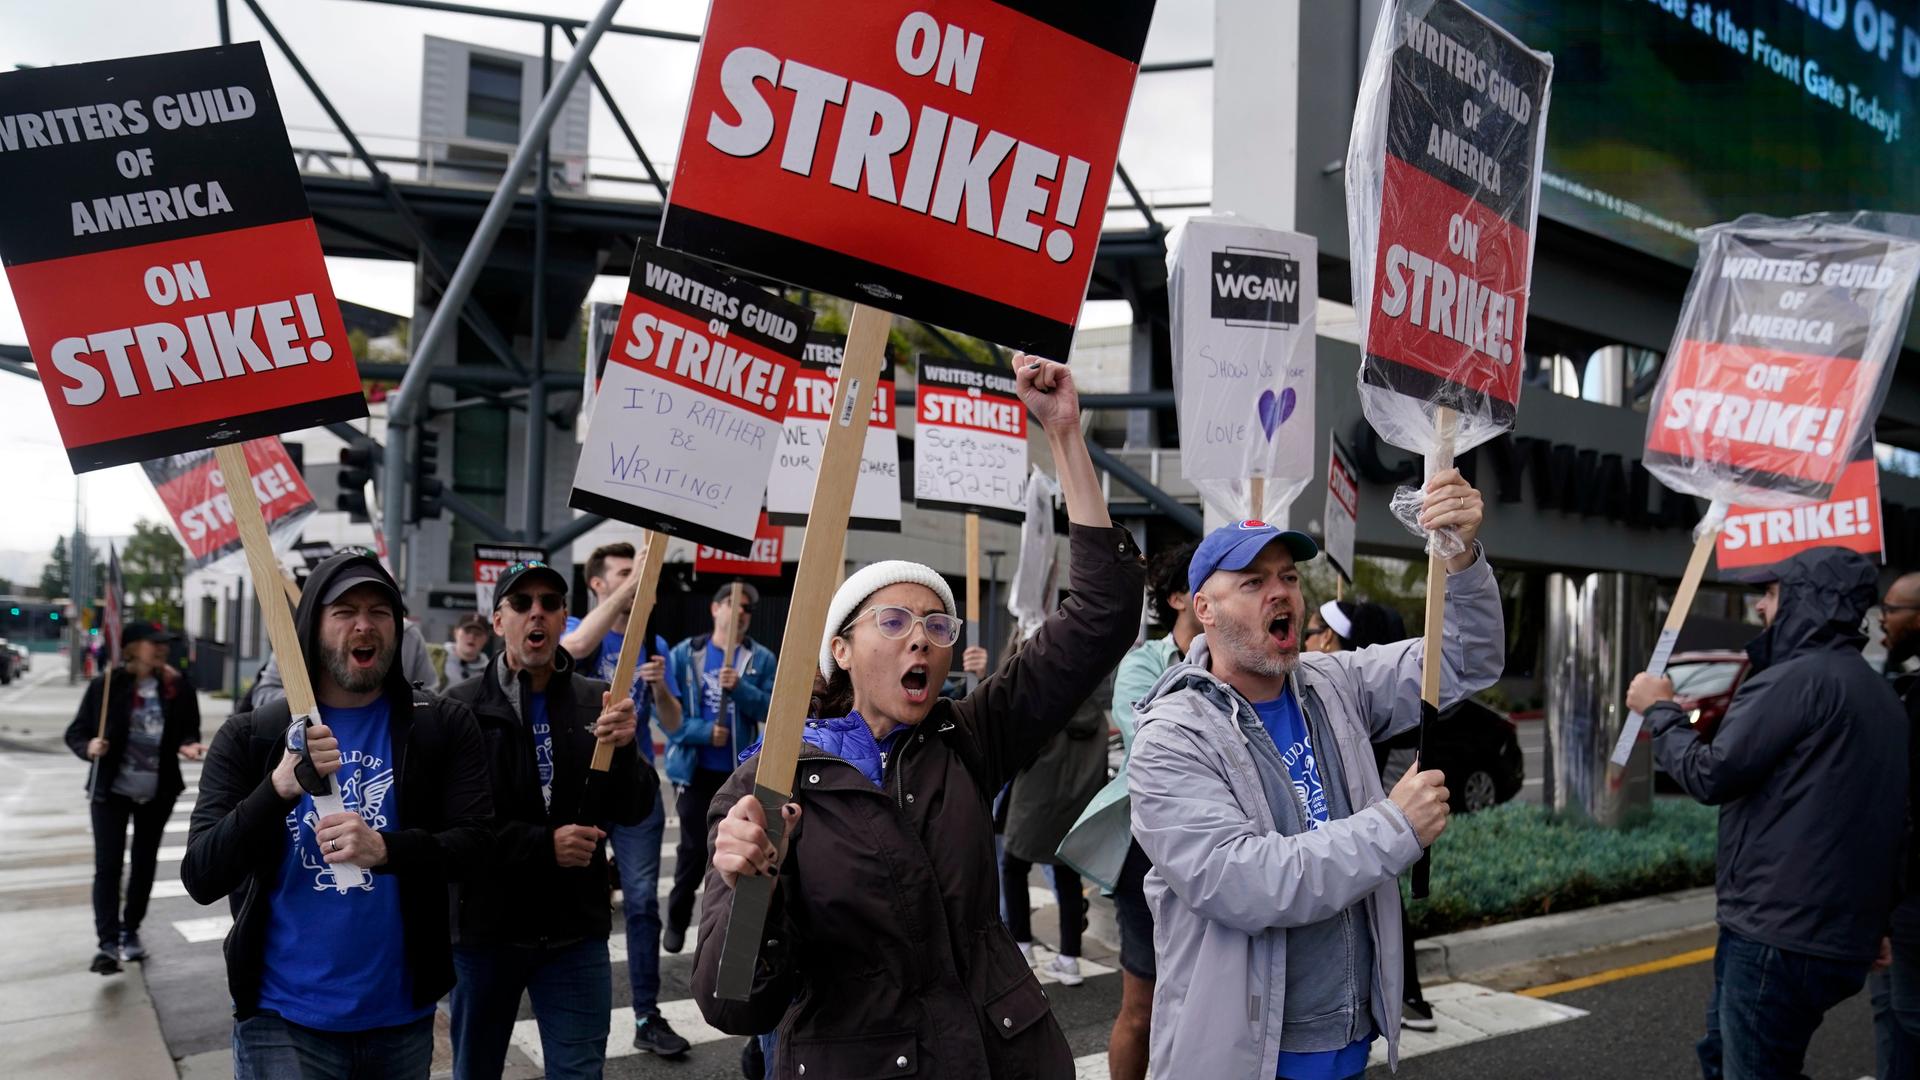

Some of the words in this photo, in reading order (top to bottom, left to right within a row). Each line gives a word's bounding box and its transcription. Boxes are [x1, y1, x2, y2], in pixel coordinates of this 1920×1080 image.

[896, 11, 985, 95] ON
[1854, 0, 1895, 61] OF
[1405, 12, 1487, 94] WRITERS
[1488, 67, 1531, 126] GUILD
[1691, 3, 1712, 36] at
[1716, 10, 1749, 54] the
[1753, 29, 1800, 85] Front
[1804, 60, 1844, 108] Gate
[1847, 83, 1901, 143] Today!
[152, 85, 257, 131] GUILD
[1463, 99, 1481, 132] OF
[115, 147, 155, 180] OF
[706, 46, 1091, 263] STRIKE!
[1427, 130, 1501, 196] AMERICA
[71, 180, 234, 237] AMERICA
[1449, 213, 1478, 263] ON
[143, 260, 211, 307] ON
[1215, 273, 1297, 303] WGAW
[1721, 257, 1819, 284] WRITERS
[1823, 263, 1894, 290] GUILD
[645, 261, 740, 320] WRITERS
[741, 304, 798, 344] GUILD
[1381, 244, 1515, 366] STRIKE!
[1780, 291, 1807, 310] OF
[50, 293, 333, 406] STRIKE!
[708, 318, 729, 338] ON
[1731, 313, 1835, 345] AMERICA
[625, 312, 785, 411] STRIKE!
[924, 365, 984, 388] WRITERS
[1745, 363, 1790, 393] ON
[923, 392, 1021, 434] STRIKE!
[967, 387, 982, 398] ON
[623, 387, 673, 414] I'D
[687, 401, 765, 450] RATHER
[669, 428, 697, 451] BE
[780, 425, 810, 446] WE
[1664, 388, 1845, 457] STRIKE!
[611, 441, 733, 505] WRITING!
[780, 454, 815, 472] OUR
[181, 462, 297, 541] STRKE!
[1723, 497, 1872, 550] STRIKE!
